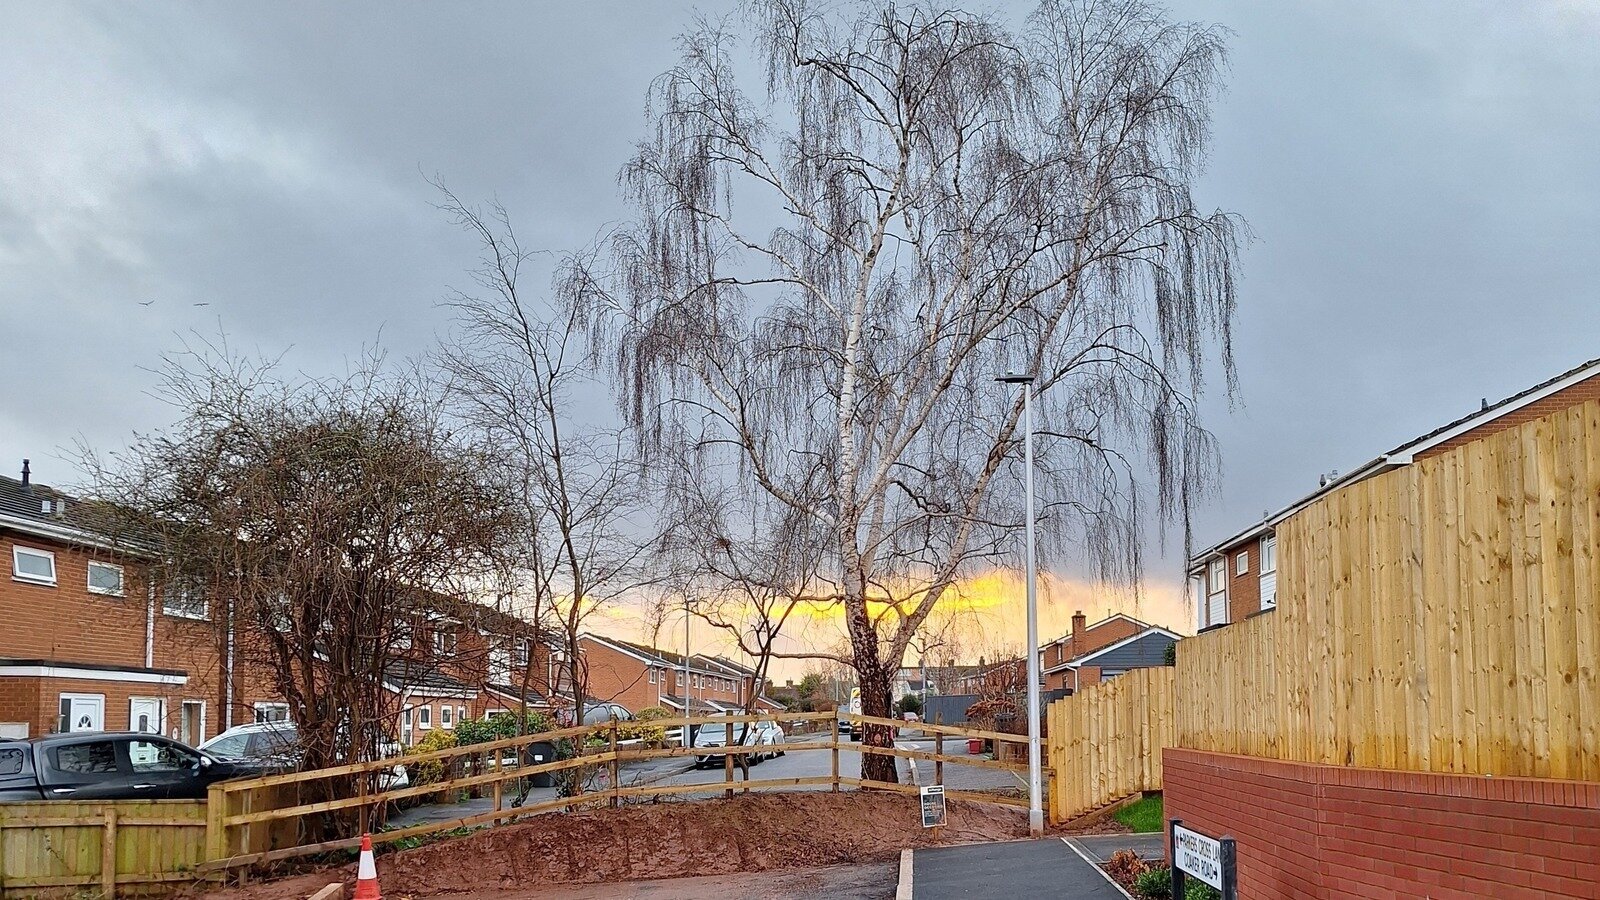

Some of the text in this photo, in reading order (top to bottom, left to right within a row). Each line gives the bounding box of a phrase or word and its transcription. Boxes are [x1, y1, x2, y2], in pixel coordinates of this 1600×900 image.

[1199, 839, 1211, 859] CROSS
[1212, 844, 1220, 863] LAN
[1201, 860, 1213, 880] ROAD
